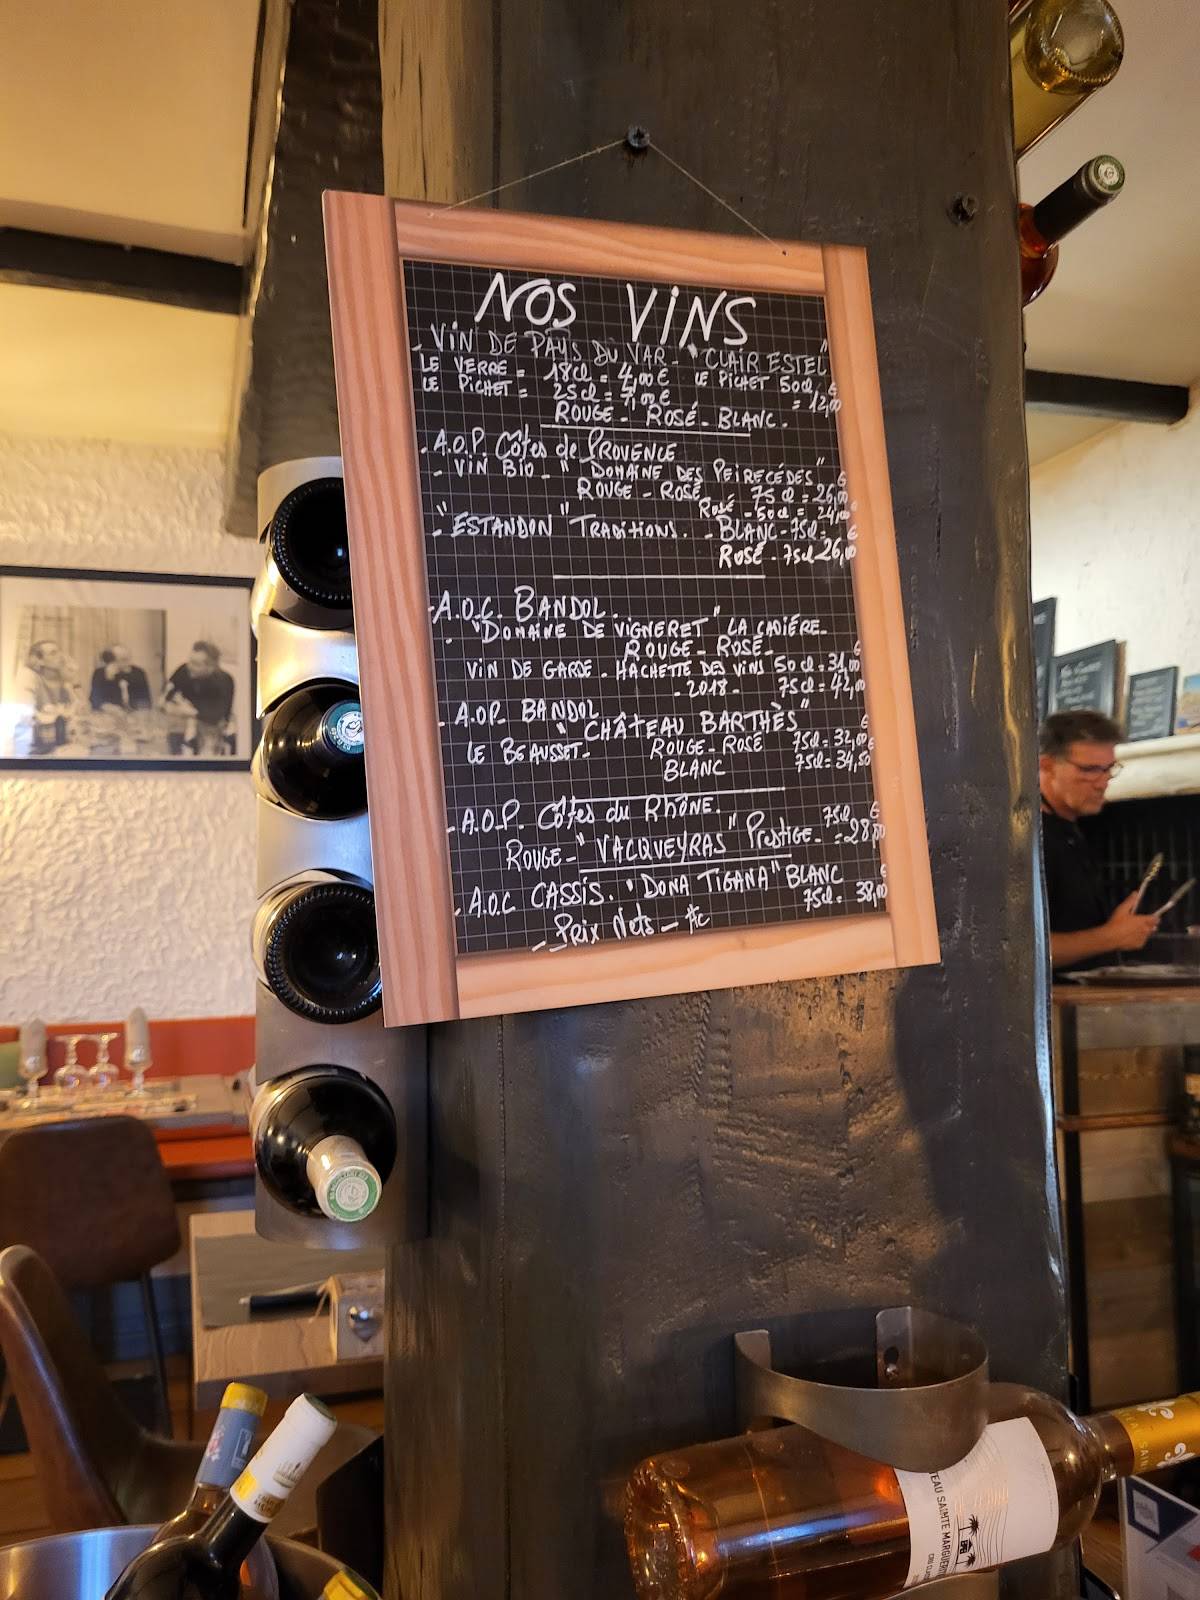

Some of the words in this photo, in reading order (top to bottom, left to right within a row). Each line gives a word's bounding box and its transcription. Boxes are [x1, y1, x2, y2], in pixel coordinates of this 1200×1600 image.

[474, 272, 577, 329] NOS
[488, 330, 518, 356] DE
[524, 327, 582, 363] PAYS
[592, 336, 619, 366] DU
[626, 342, 667, 370] VAR
[419, 353, 440, 373] LE
[453, 355, 508, 377] VERRE
[695, 370, 708, 387] LE
[422, 376, 440, 393] LE
[555, 402, 615, 424] ROUGE
[646, 400, 699, 428] ROSÉ
[555, 432, 577, 461] de
[676, 465, 704, 486] DES
[576, 477, 633, 501] ROUGE
[582, 620, 605, 639] DE
[727, 617, 748, 637] LA
[624, 638, 694, 662] ROUGE
[717, 634, 764, 657] ROSÉ
[511, 658, 532, 680] DE
[701, 660, 726, 677] DES
[686, 678, 729, 699] 2018
[521, 698, 600, 723] BANDOL
[467, 740, 486, 765] LE
[650, 738, 706, 760] ROUGE
[664, 758, 727, 782] BLANC
[605, 800, 630, 823] du
[505, 838, 563, 873] ROUGE
[785, 863, 844, 889] BLANC
[936, 1495, 951, 1530] SAINTE
